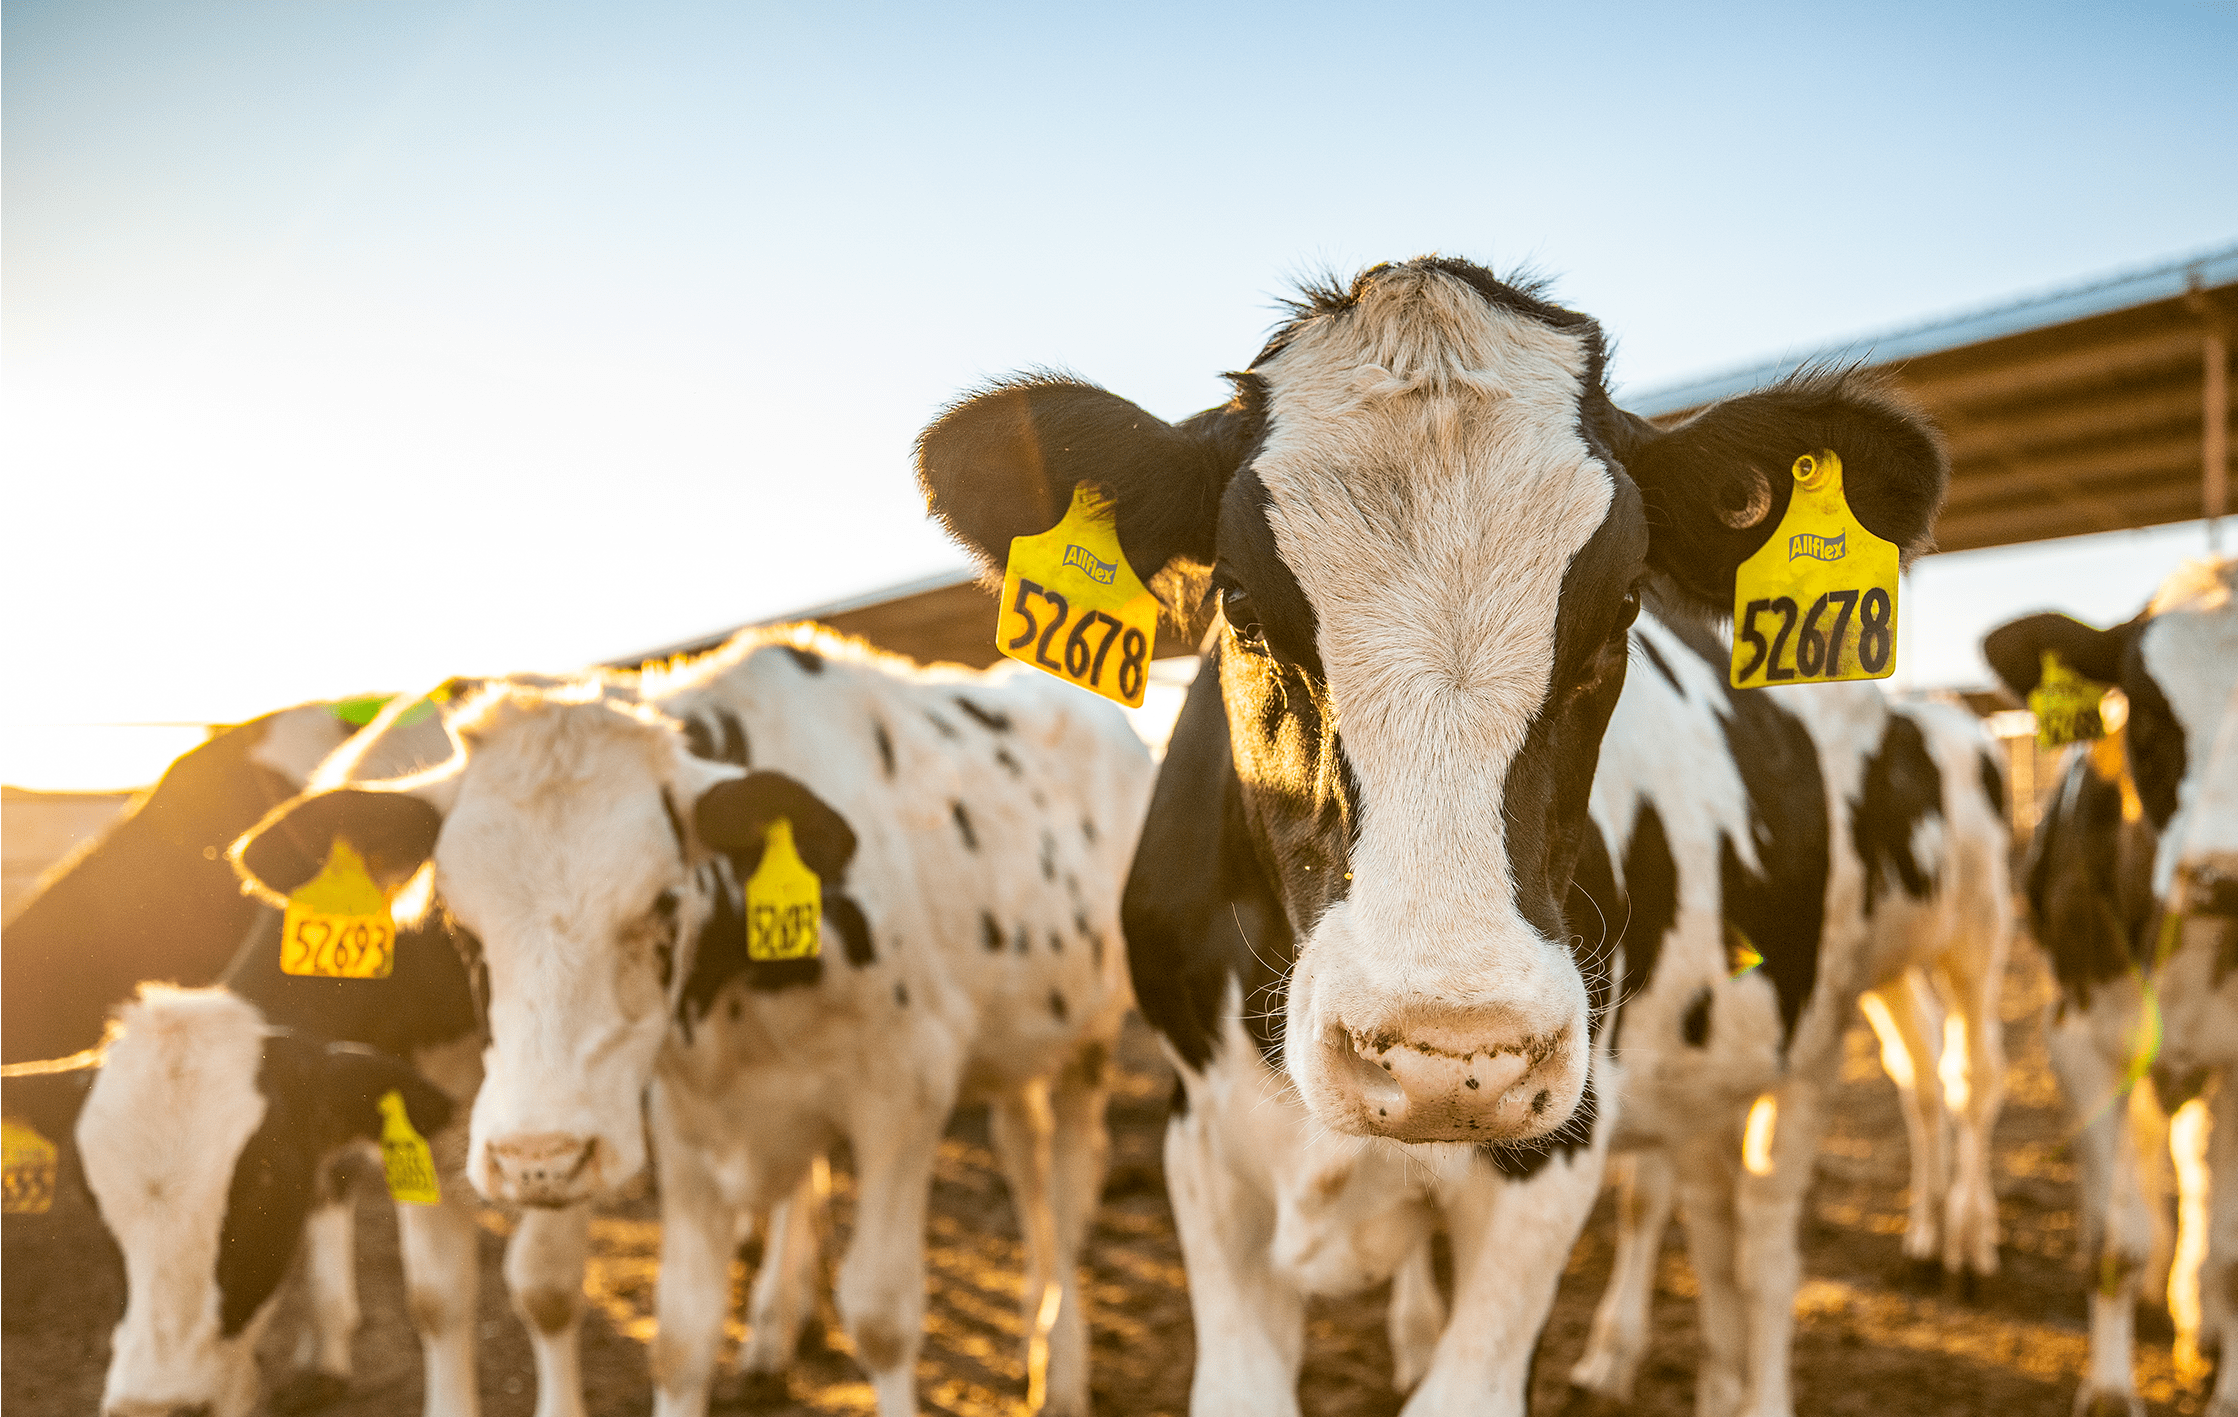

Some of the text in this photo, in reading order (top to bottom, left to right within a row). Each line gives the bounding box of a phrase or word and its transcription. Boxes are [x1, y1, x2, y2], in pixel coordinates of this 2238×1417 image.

[1064, 546, 1117, 584] Allflex
[1790, 534, 1845, 561] Allflex
[1009, 577, 1146, 700] 52678
[1738, 587, 1891, 683] 52678
[294, 919, 388, 977] 52693
